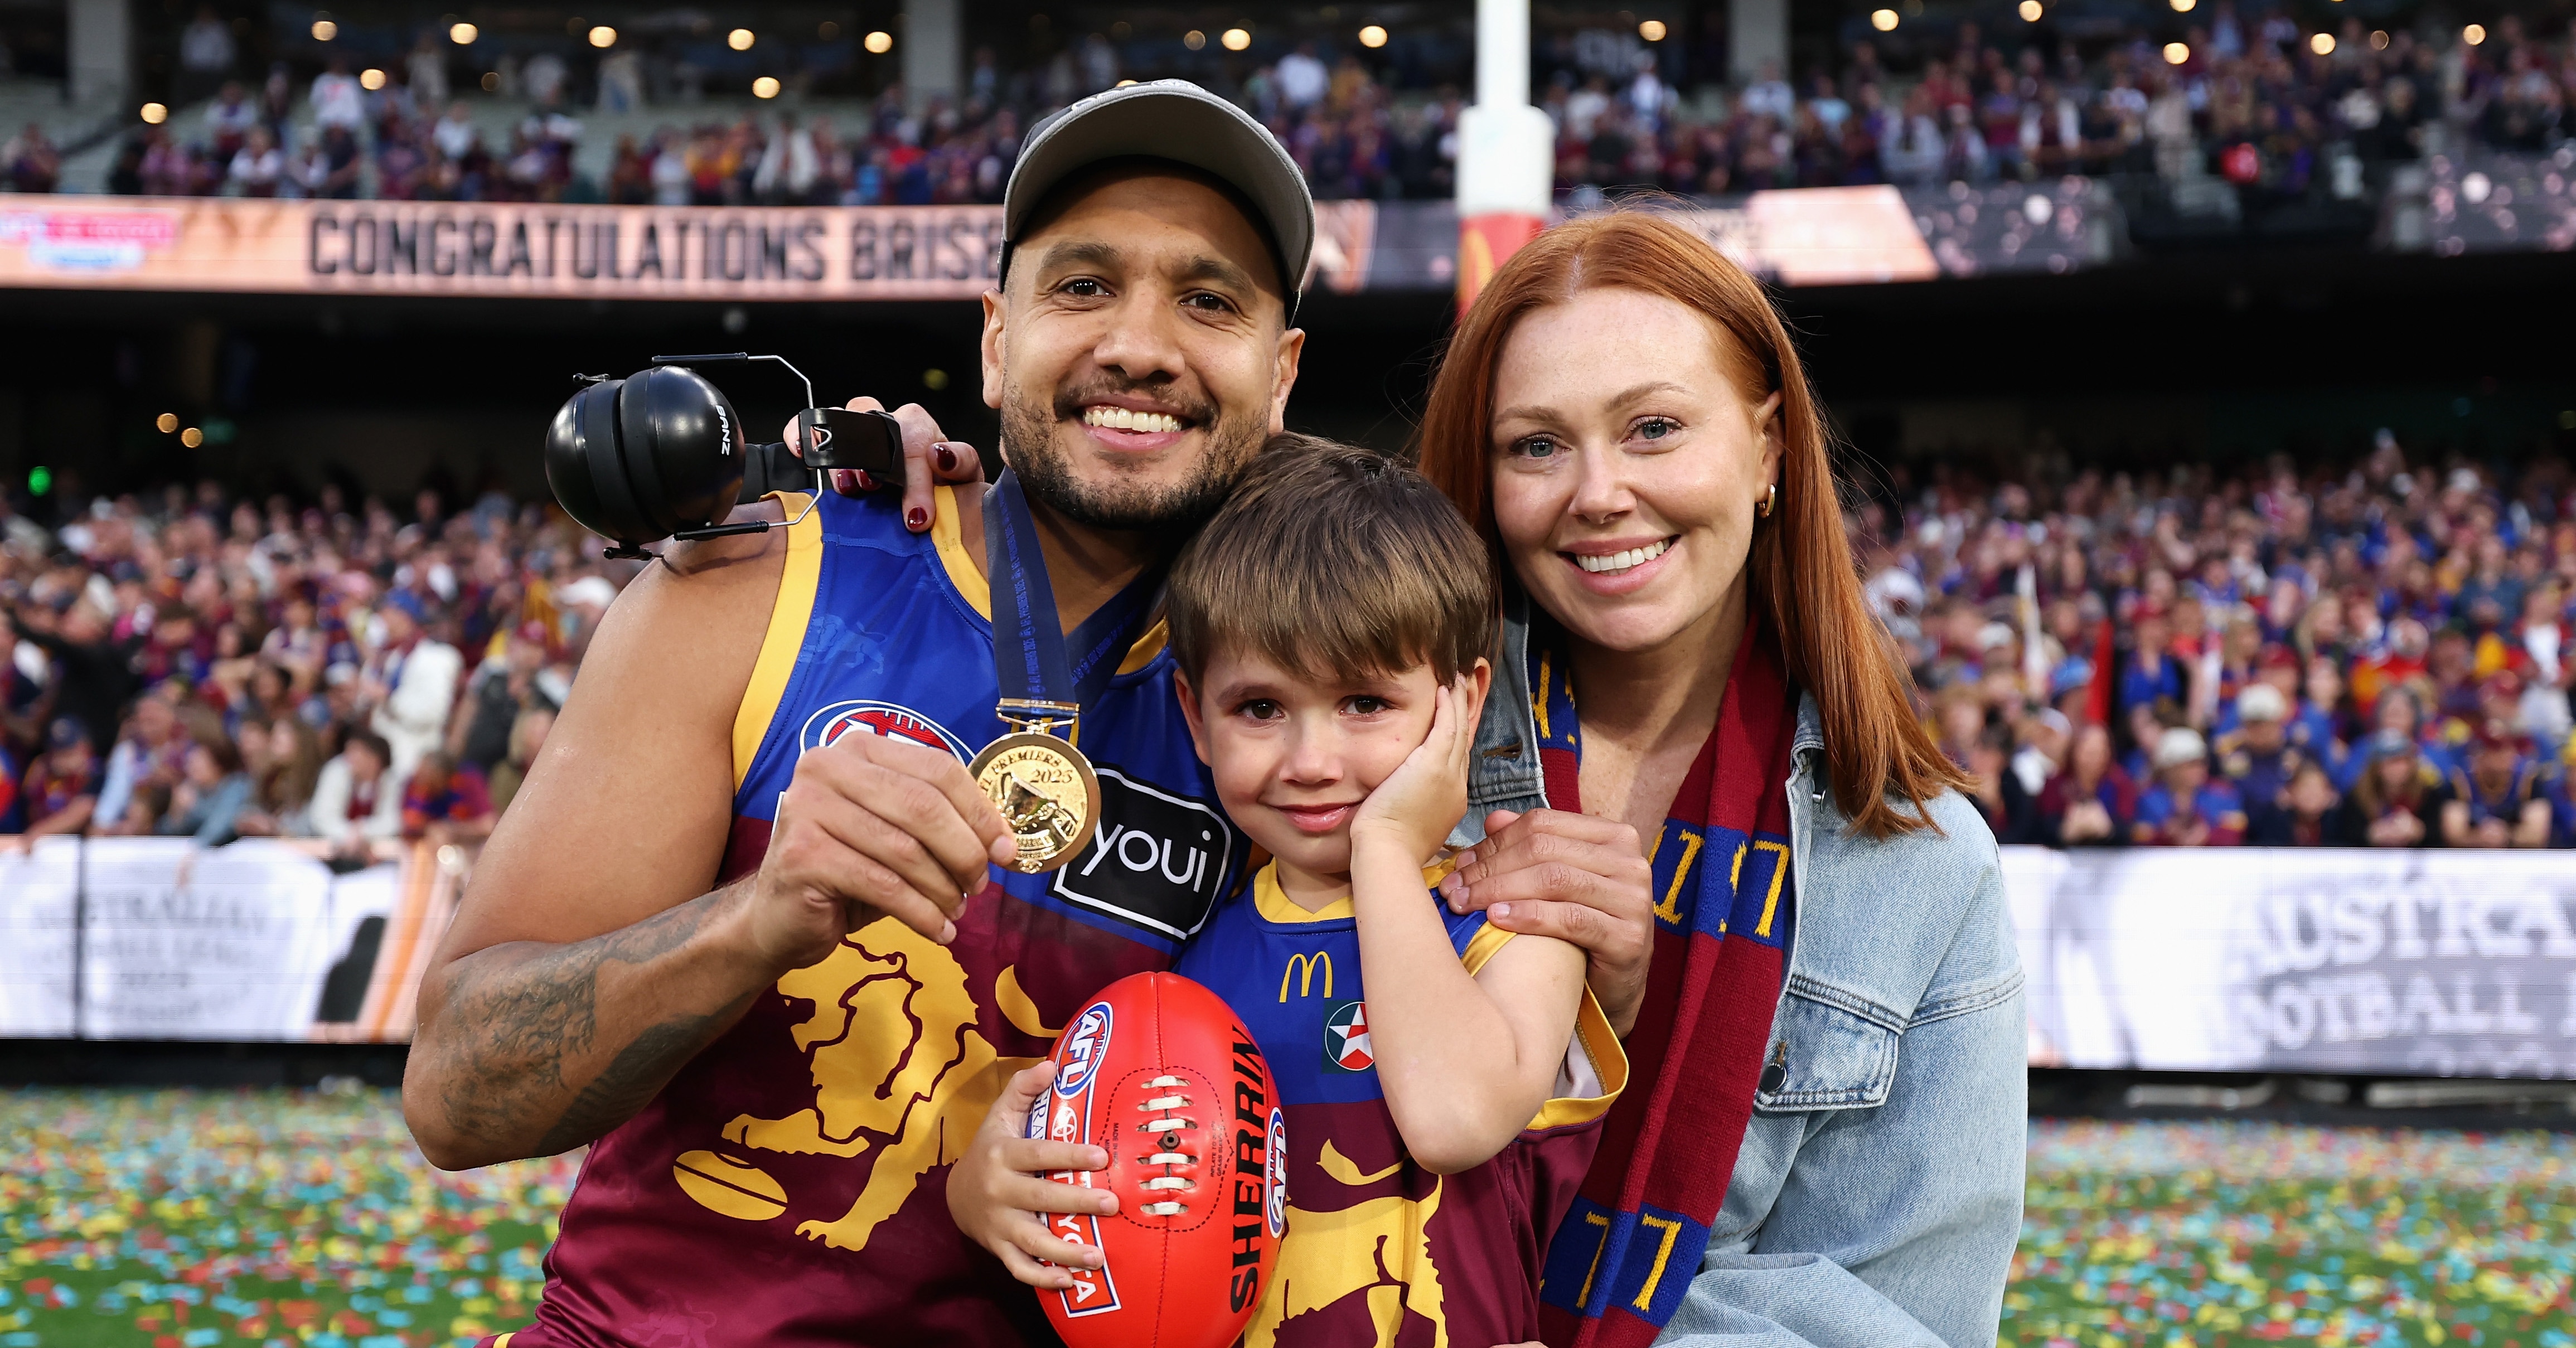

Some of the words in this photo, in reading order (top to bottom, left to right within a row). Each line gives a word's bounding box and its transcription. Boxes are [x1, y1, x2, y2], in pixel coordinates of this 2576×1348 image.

[311, 216, 826, 280] CONGRATULATIONS
[715, 405, 730, 455] BANZ
[979, 777, 992, 792] FL
[991, 749, 1061, 774] PREMIERS
[1030, 768, 1073, 783] 2025
[1080, 818, 1211, 893] youi
[1060, 1012, 1103, 1090] AFL
[1231, 1024, 1265, 1313] SHERRIN
[1273, 1131, 1287, 1225] AFL
[1053, 1168, 1096, 1303] TYTA
